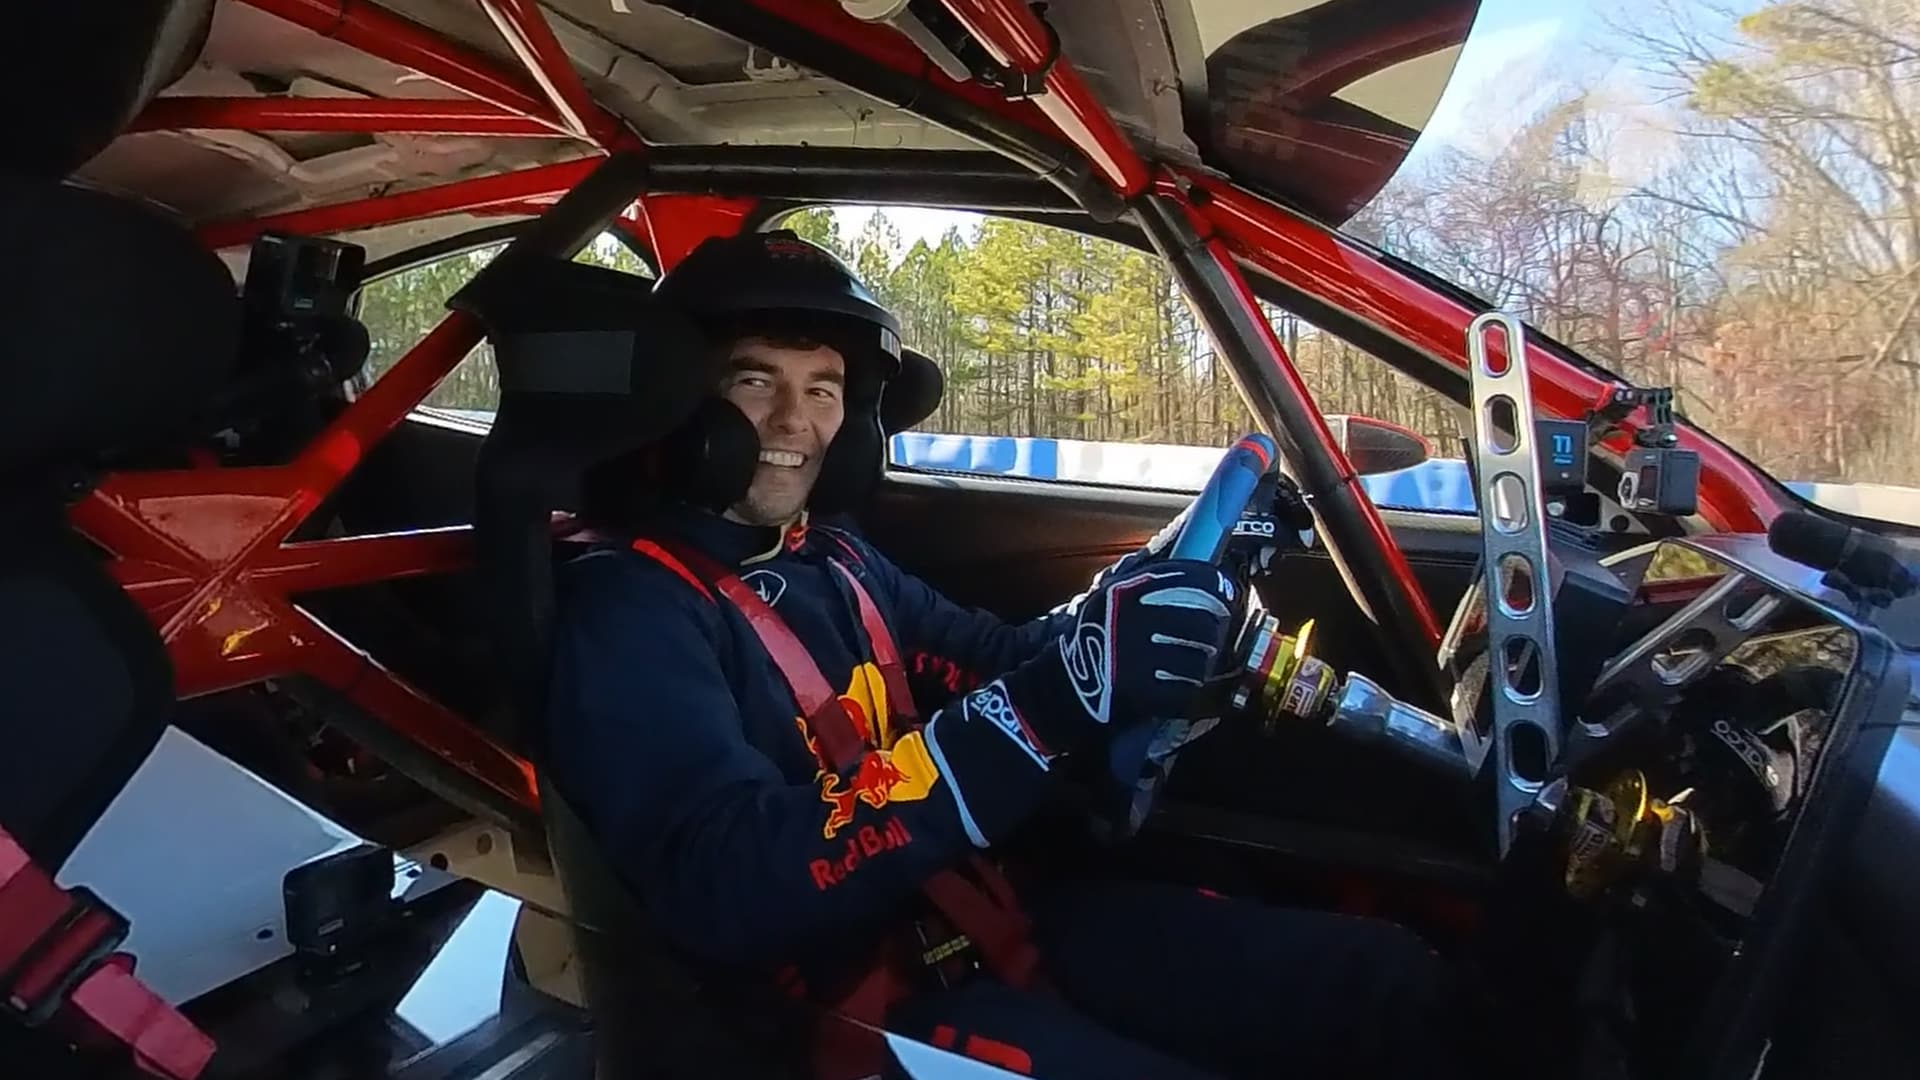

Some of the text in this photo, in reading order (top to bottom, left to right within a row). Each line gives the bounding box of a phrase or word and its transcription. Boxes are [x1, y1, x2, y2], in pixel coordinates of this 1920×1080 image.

[1233, 520, 1275, 533] arco
[810, 816, 912, 890] Red Bull
